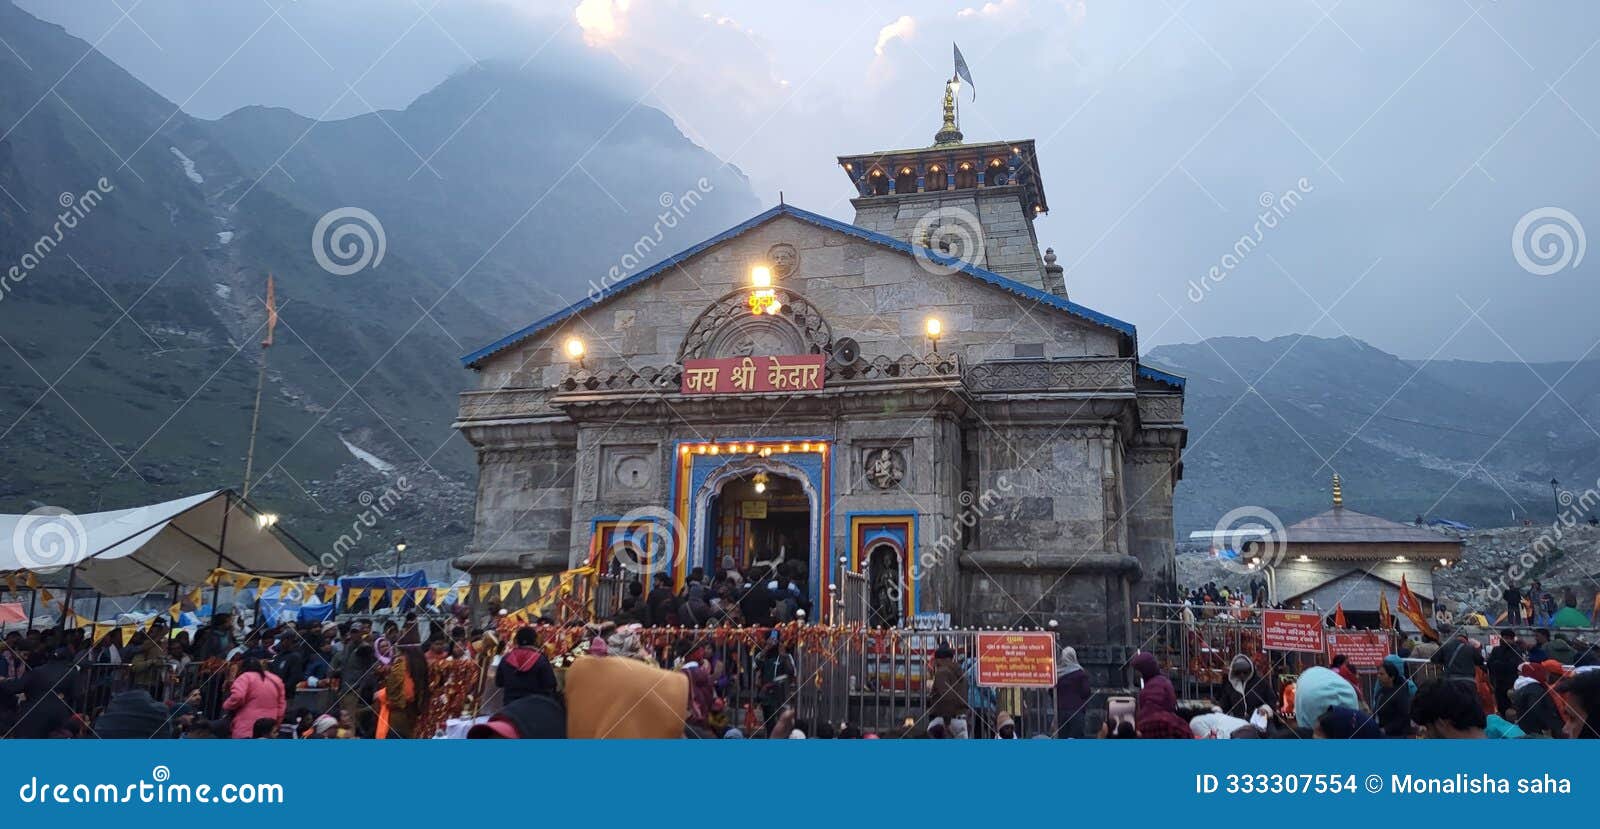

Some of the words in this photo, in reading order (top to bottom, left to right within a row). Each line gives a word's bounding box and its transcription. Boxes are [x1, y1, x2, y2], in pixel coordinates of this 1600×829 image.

[686, 368, 719, 392] जय
[730, 357, 756, 391] श्री
[768, 356, 820, 389] केदार
